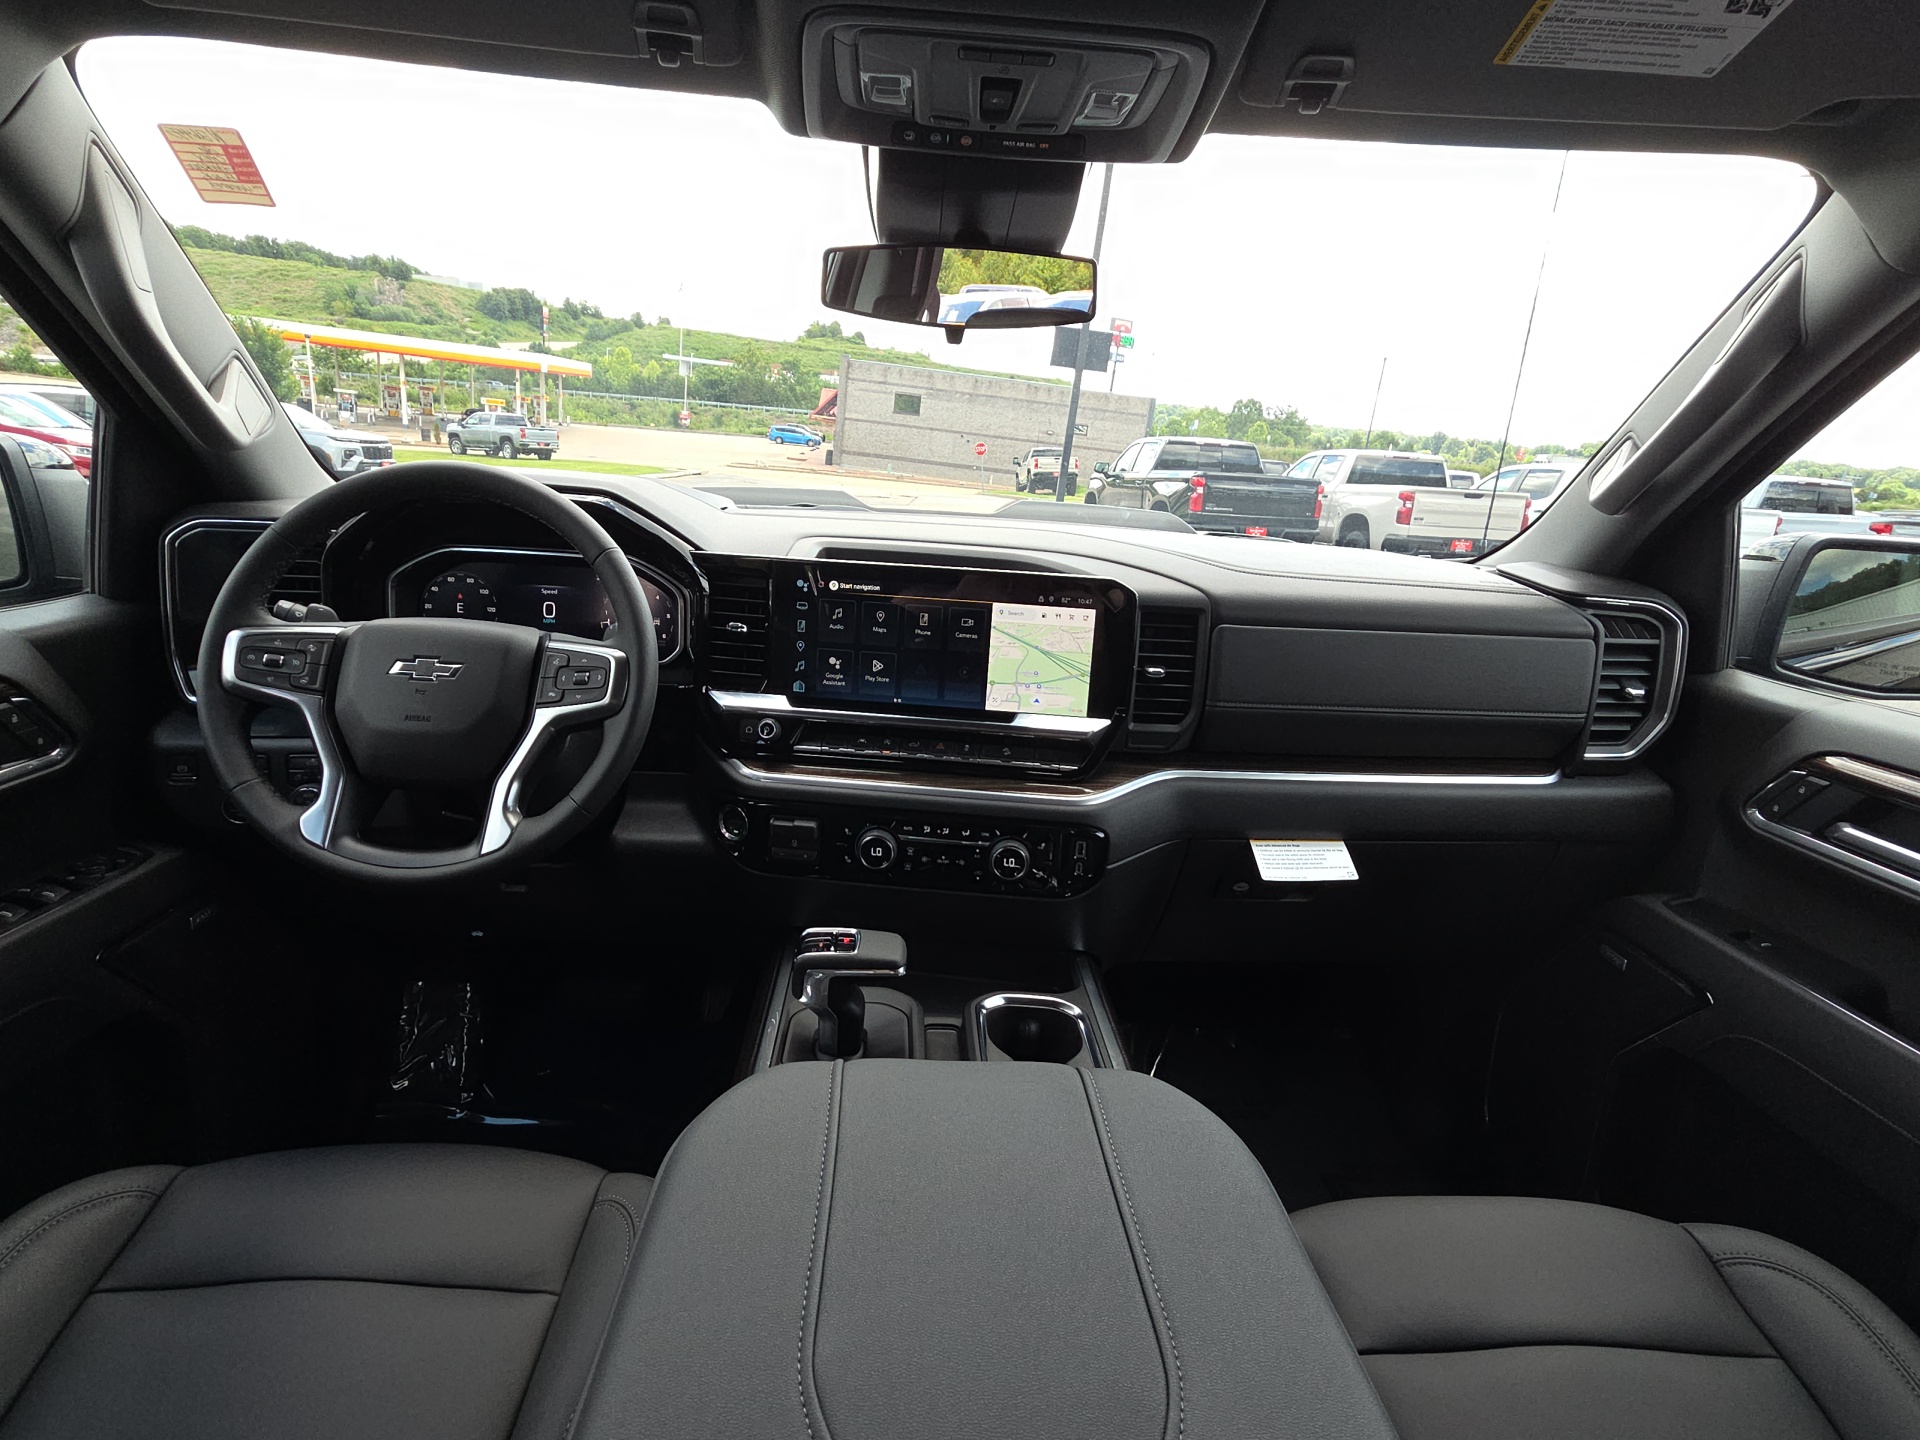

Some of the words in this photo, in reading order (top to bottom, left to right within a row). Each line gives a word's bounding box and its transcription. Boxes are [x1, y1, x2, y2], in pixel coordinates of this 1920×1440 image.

[853, 583, 881, 591] navigation
[541, 588, 558, 596] Speed
[456, 602, 465, 613] E
[543, 601, 556, 618] 0
[955, 631, 978, 639] Cameras
[825, 672, 844, 680] Google
[864, 675, 876, 683] Play
[822, 679, 846, 687] Assistant
[403, 714, 431, 722] AIRBAG
[870, 846, 882, 857] LO
[1003, 858, 1016, 867] LO
